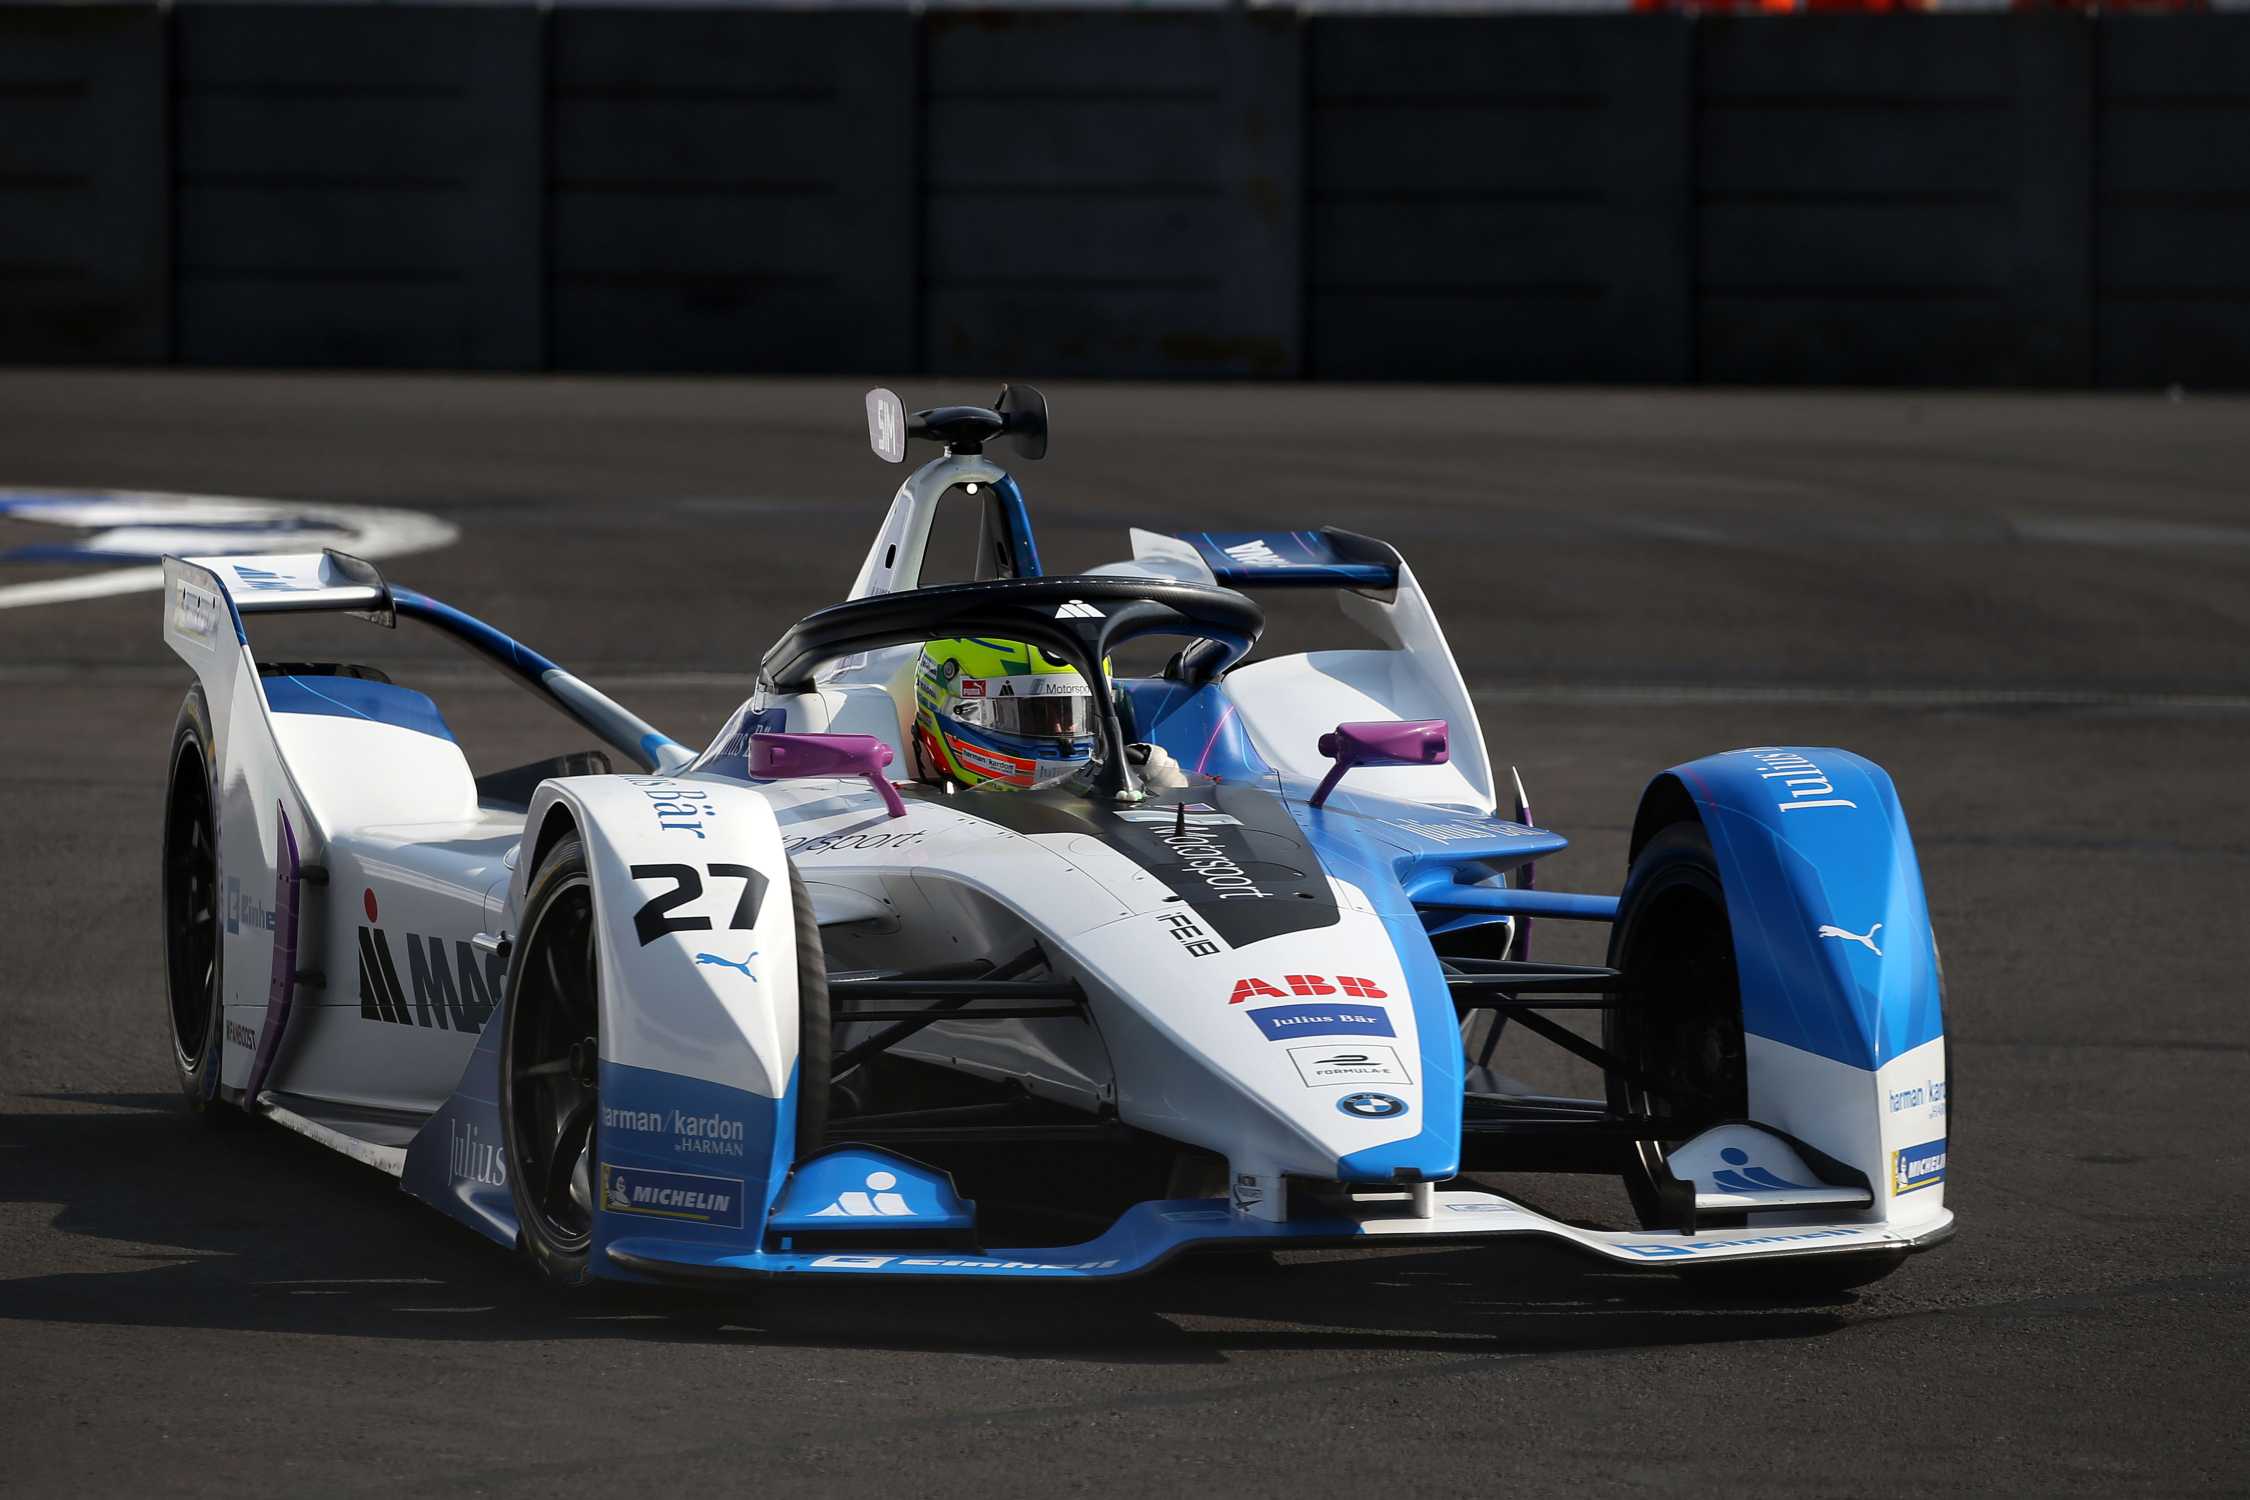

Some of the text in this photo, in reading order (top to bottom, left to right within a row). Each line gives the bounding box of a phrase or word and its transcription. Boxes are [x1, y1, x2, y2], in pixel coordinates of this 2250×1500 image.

[1753, 754, 1857, 812] Julius
[783, 830, 927, 855] orsport
[630, 863, 769, 947] 27
[1228, 974, 1388, 1004] ABB
[1272, 1013, 1377, 1027] Julius Bär
[448, 1118, 506, 1187] Julius
[633, 1185, 731, 1212] MICHELIN
